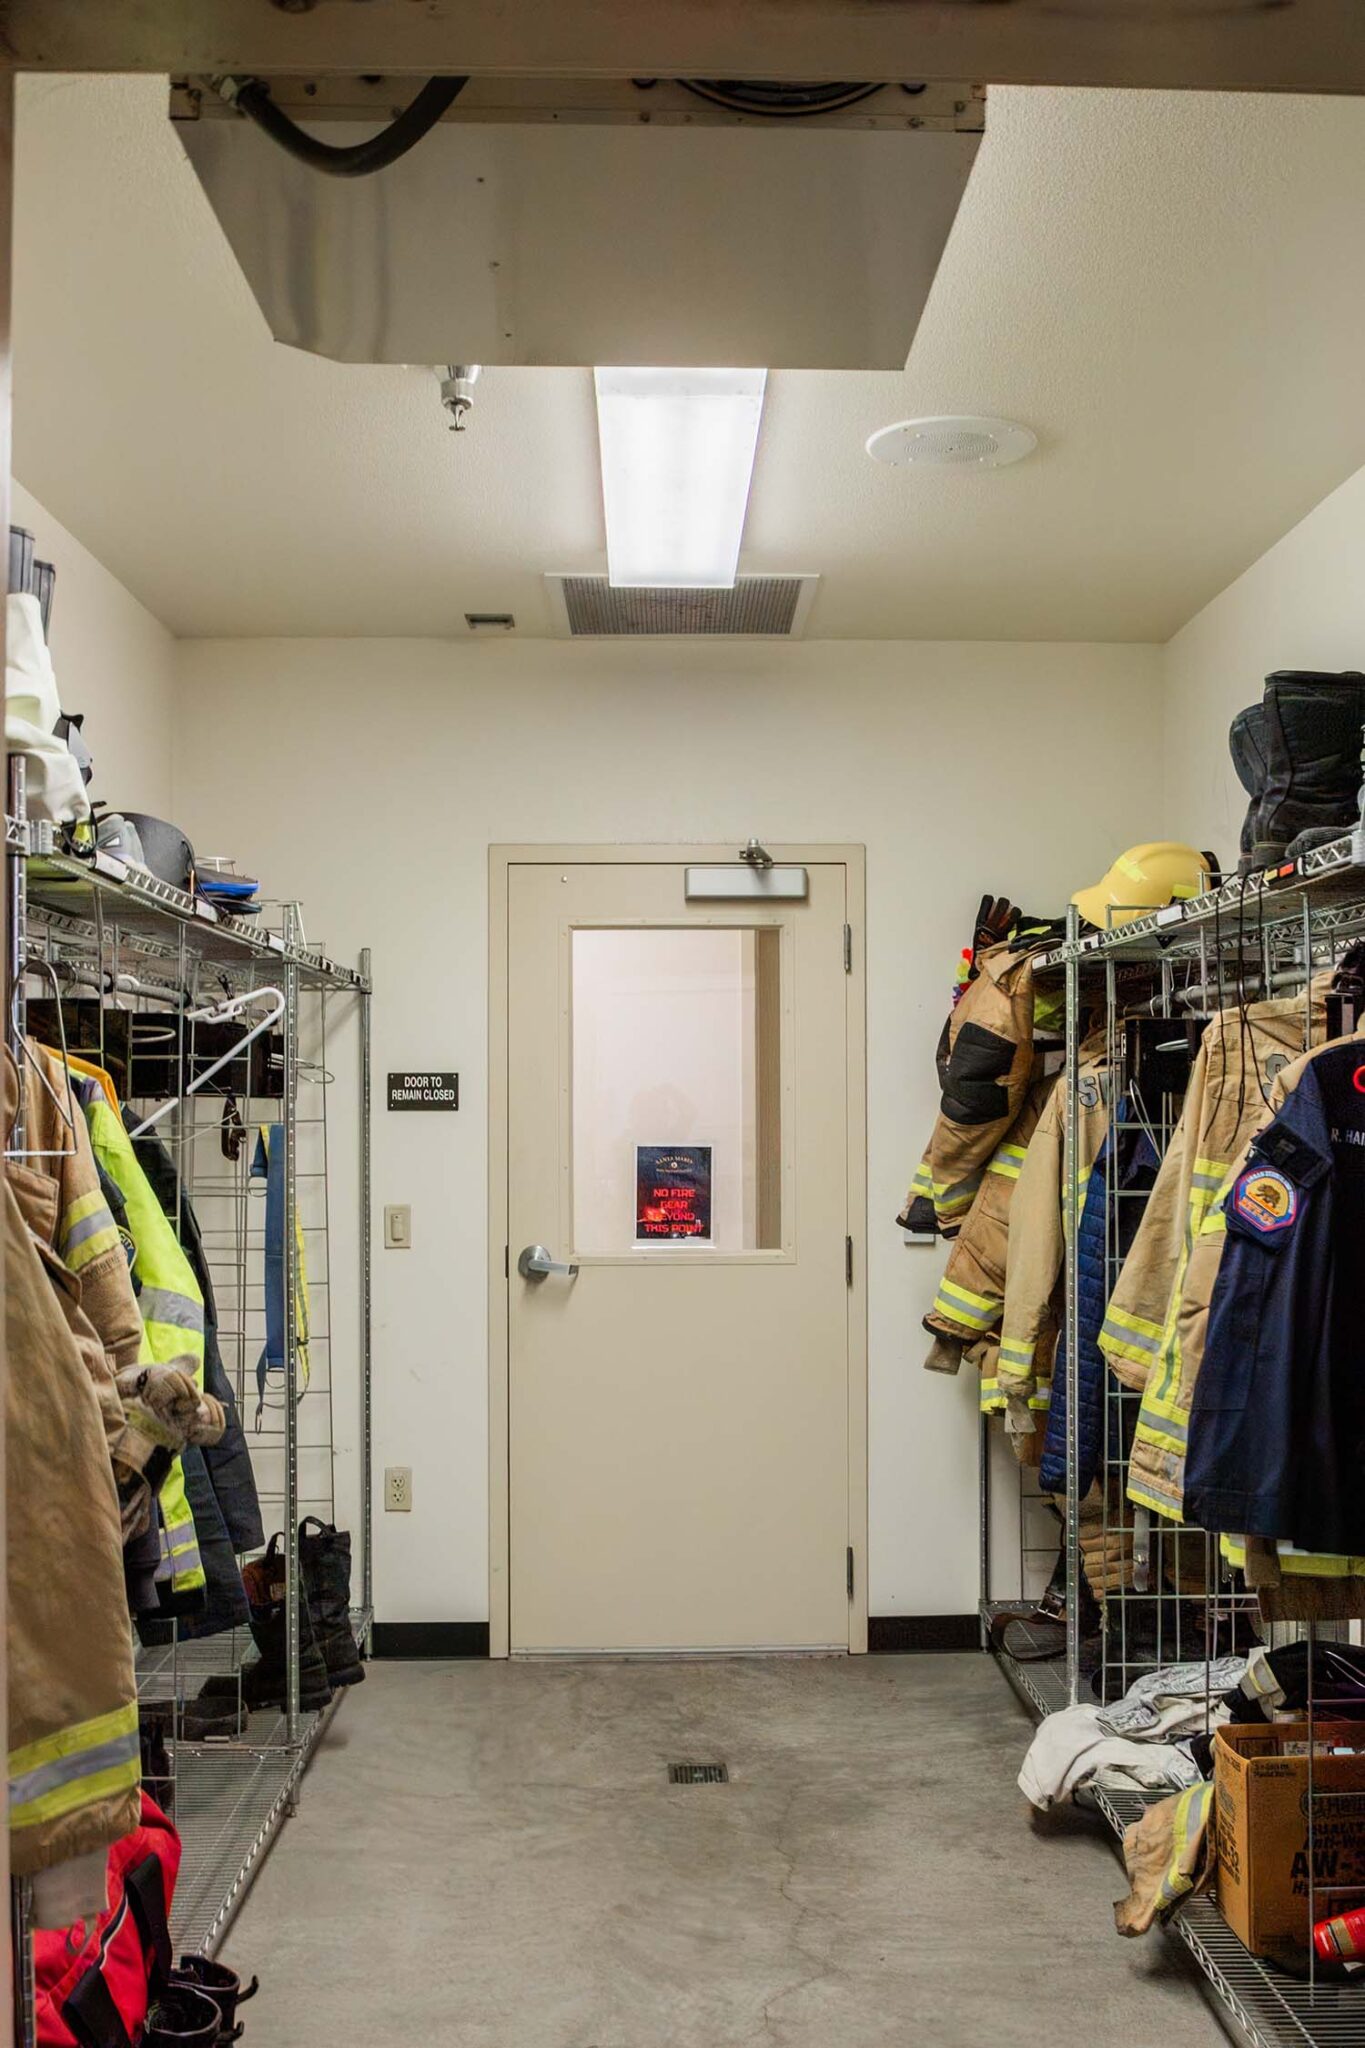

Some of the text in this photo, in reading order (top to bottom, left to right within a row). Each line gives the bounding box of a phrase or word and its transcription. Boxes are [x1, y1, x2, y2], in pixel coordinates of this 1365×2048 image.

[404, 1076, 442, 1087] DOOR TO
[391, 1089, 455, 1100] REMAIN CLOSED
[654, 1189, 695, 1197] NO FIRE
[660, 1200, 688, 1209] GEAR
[654, 1212, 695, 1221] EYOND
[645, 1224, 703, 1232] THIS POINT
